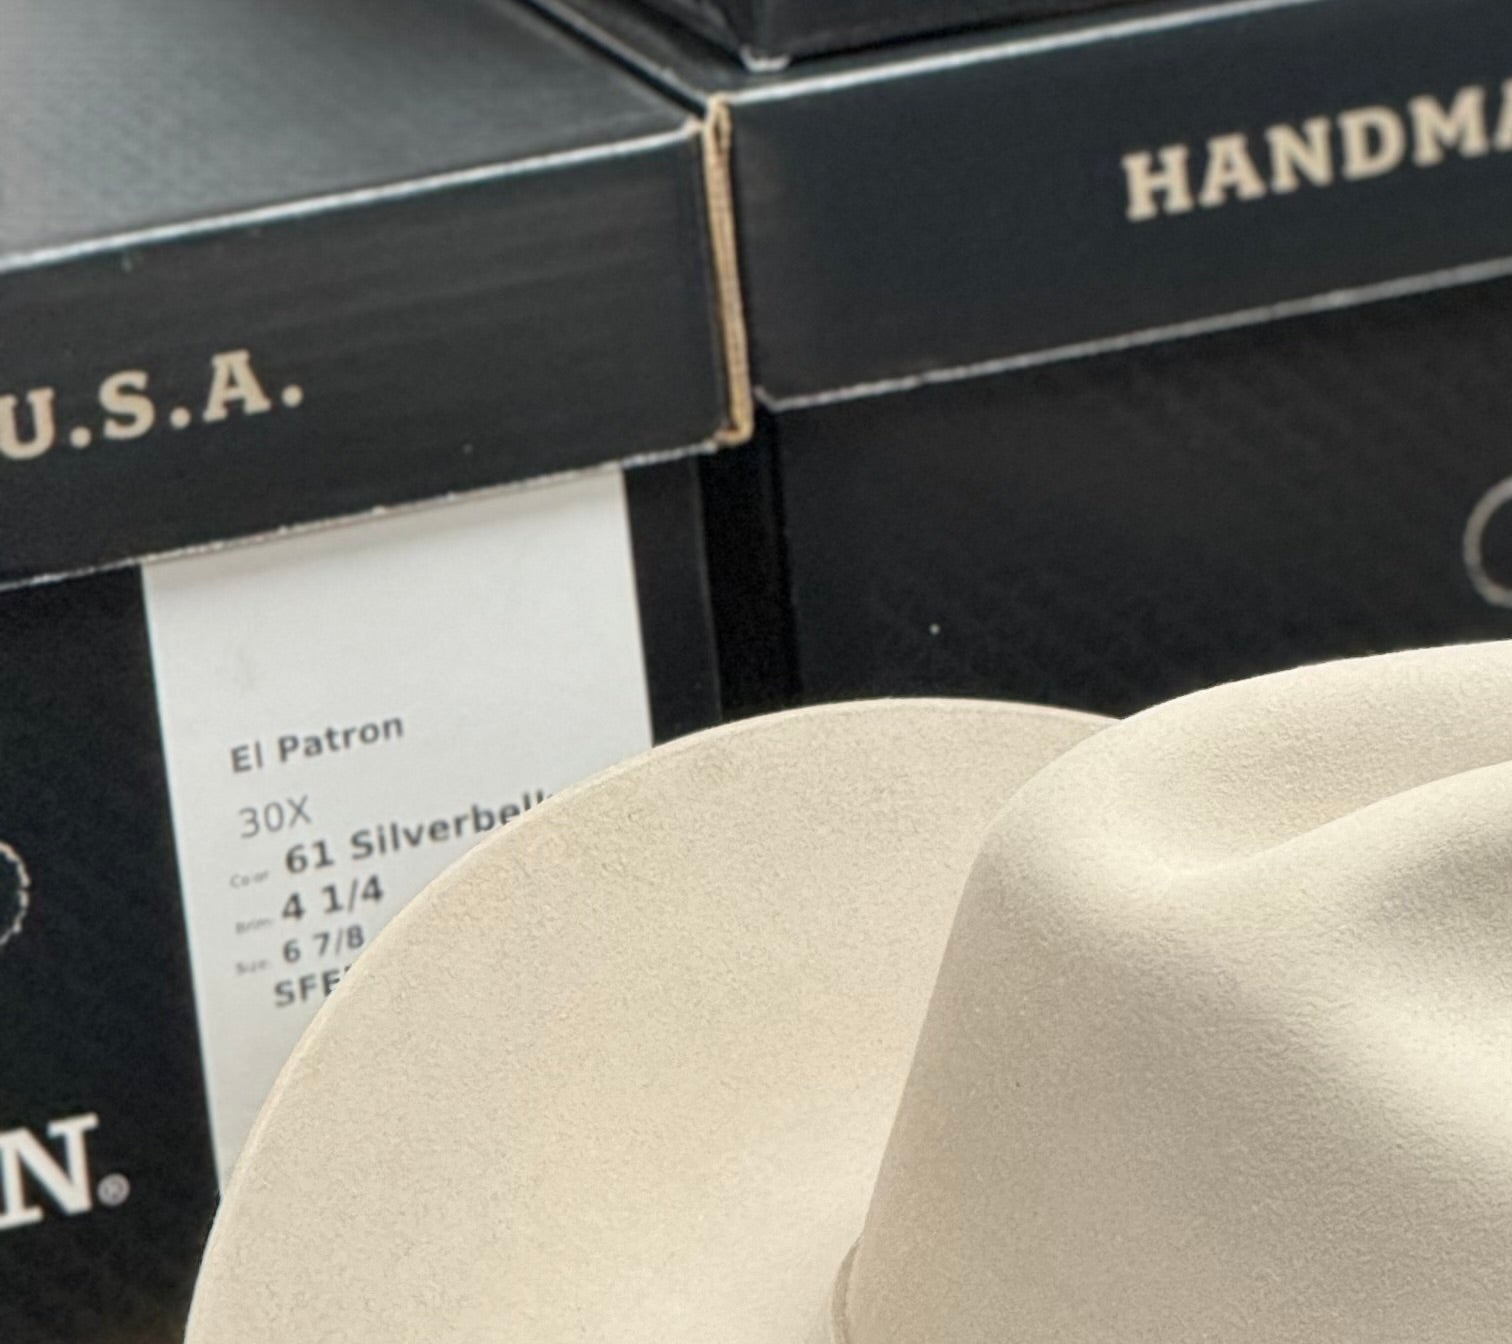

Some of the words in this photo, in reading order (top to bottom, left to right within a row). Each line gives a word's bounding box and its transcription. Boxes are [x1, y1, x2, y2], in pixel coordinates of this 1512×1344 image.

[230, 740, 264, 776] El
[277, 715, 406, 764] Patron
[238, 794, 313, 840] 30X
[284, 839, 335, 876] 61
[281, 892, 307, 923] 4
[321, 874, 386, 915] 1/4
[281, 938, 302, 966] 6
[311, 923, 367, 957] 7/8
